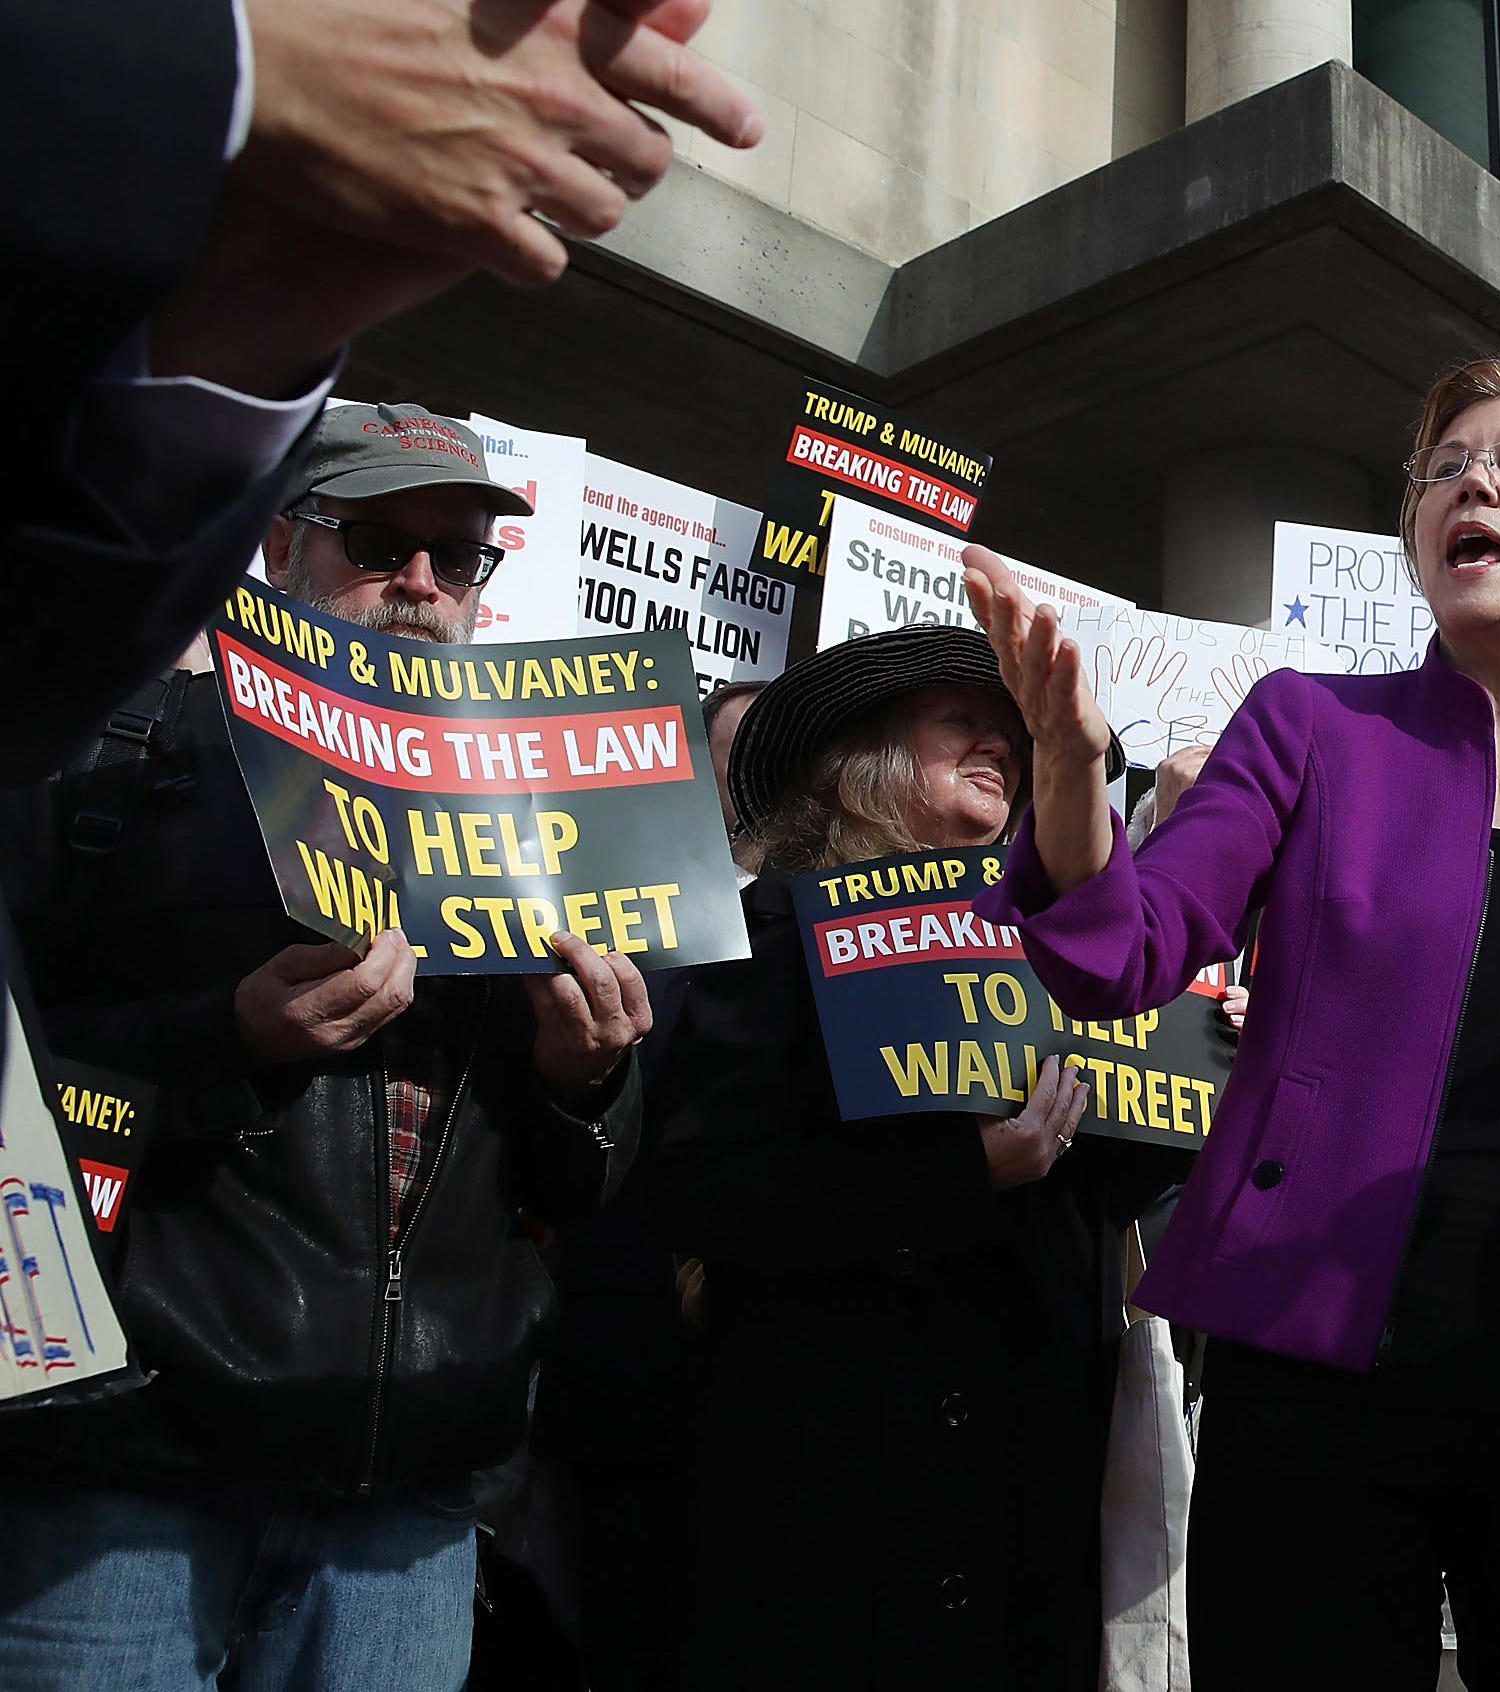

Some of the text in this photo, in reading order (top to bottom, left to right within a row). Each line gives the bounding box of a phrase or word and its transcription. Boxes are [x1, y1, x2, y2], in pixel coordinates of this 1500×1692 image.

[399, 436, 479, 467] SCIENCE
[805, 392, 986, 487] TRUMP & MULVANEY:
[794, 433, 974, 525] BREAKING THE LAW
[617, 496, 638, 518] the
[642, 507, 690, 536] agency
[692, 519, 726, 548] that...
[581, 519, 787, 617] WELLS FARGO
[578, 576, 761, 665] 100 MILLION
[1077, 605, 1217, 647] HANDS
[1310, 594, 1396, 646] THE
[349, 640, 379, 689] &
[388, 650, 660, 701] MULVANEY:
[1175, 686, 1217, 707] THE
[227, 649, 679, 781] BREAKING THE LAW
[323, 778, 579, 877] TO HELP
[819, 856, 1005, 907] TRUMP &
[440, 883, 681, 960] STREET
[944, 972, 1028, 1026] TO
[880, 1040, 1038, 1104] WALL
[57, 1083, 135, 1137] ANEY:
